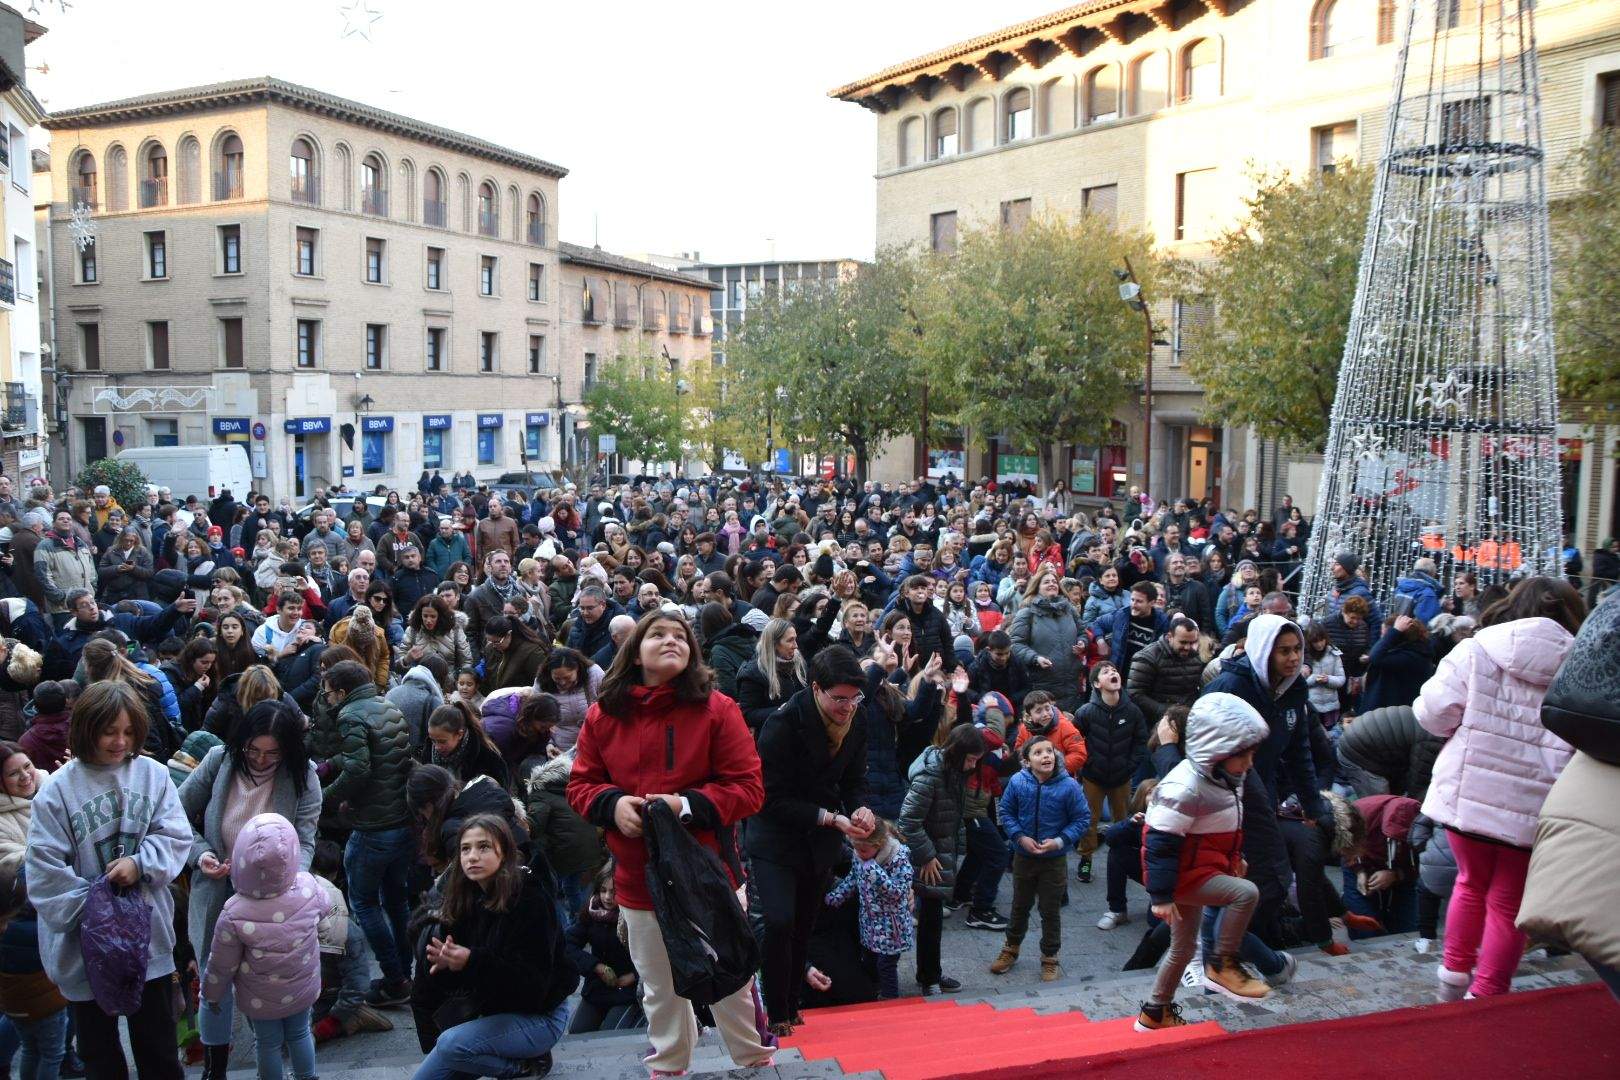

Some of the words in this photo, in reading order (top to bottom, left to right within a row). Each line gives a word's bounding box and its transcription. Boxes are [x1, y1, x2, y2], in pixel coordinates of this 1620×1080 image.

[302, 420, 323, 430] BBVA
[369, 420, 387, 429] BBVA
[429, 418, 445, 427] BBVA
[482, 417, 498, 425] BBVA
[220, 421, 241, 431] BBVA
